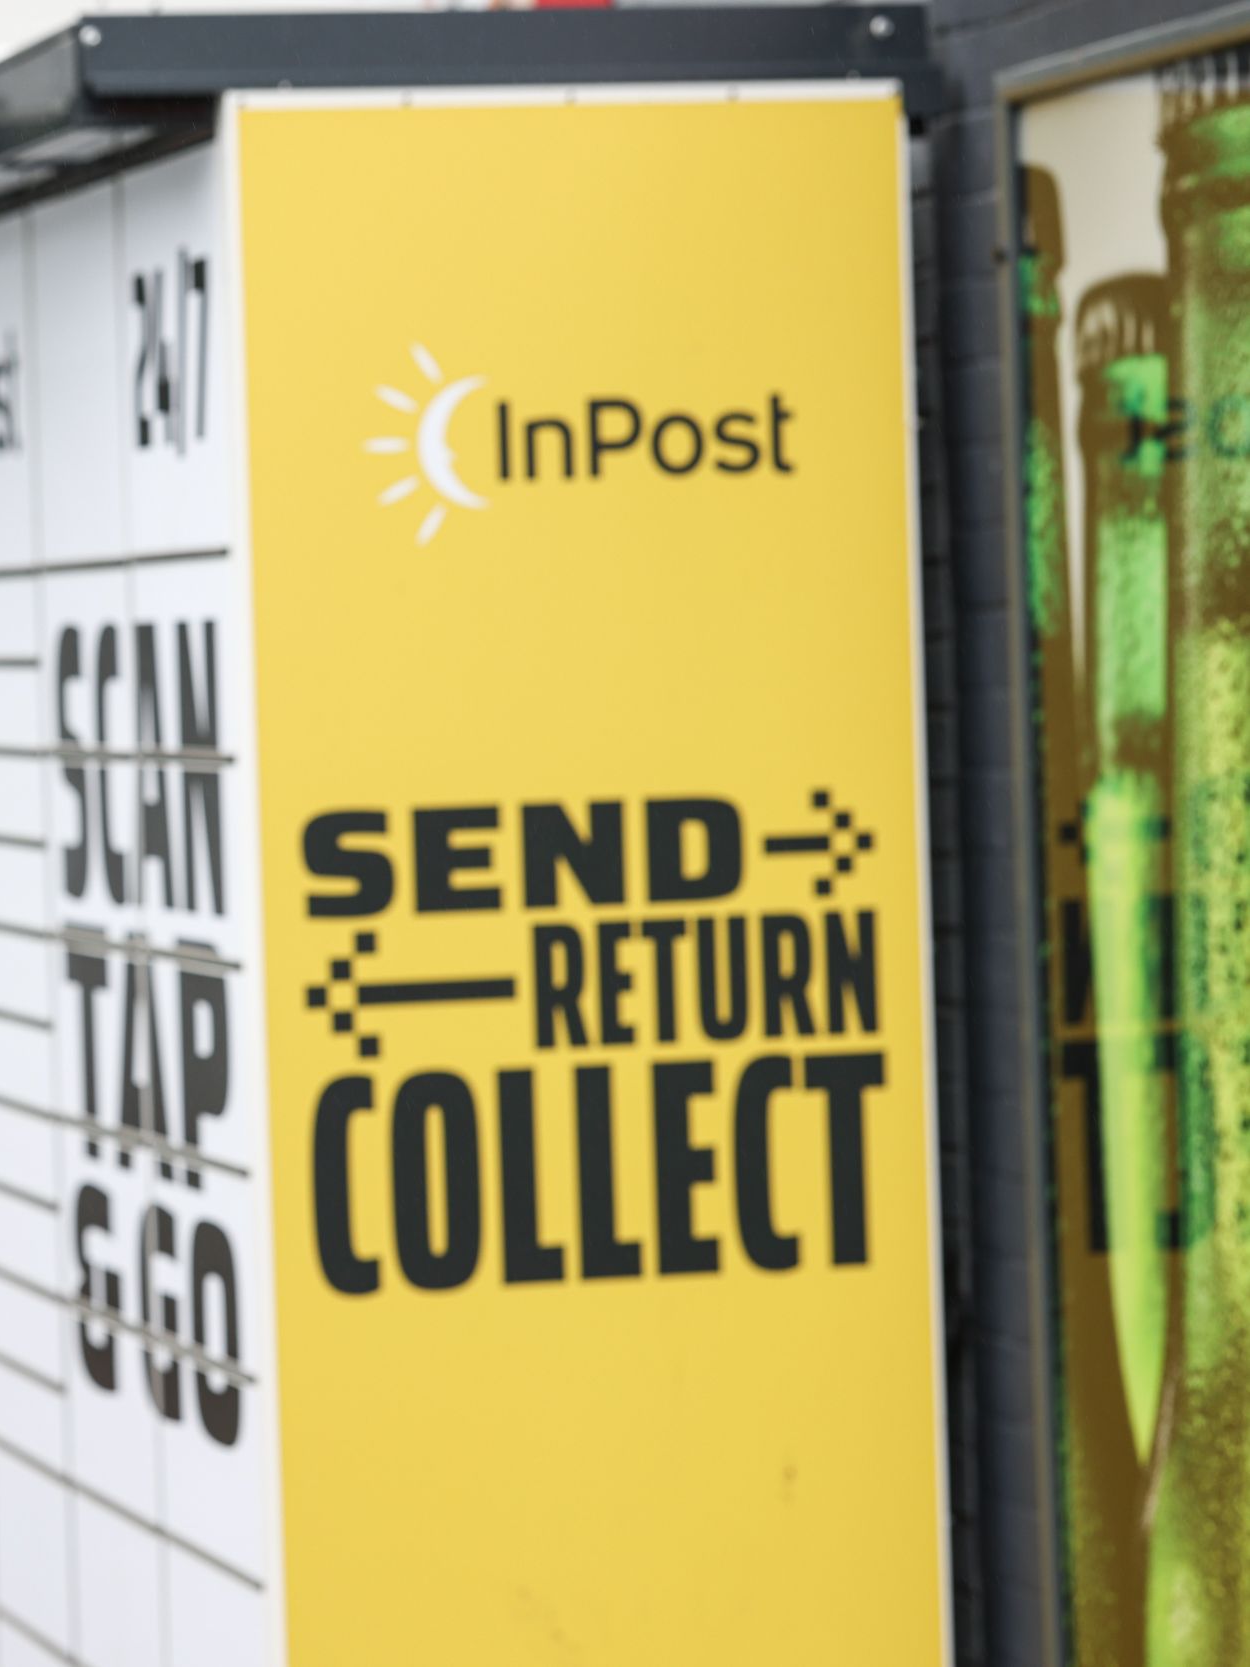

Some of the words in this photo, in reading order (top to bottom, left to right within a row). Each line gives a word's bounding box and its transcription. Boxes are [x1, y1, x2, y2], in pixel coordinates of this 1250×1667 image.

[133, 246, 207, 457] 24/7
[496, 392, 795, 481] InPost
[58, 619, 225, 917] SCAN
[300, 794, 745, 921] SEND
[63, 922, 230, 1191] TAP
[532, 907, 883, 1051] RETURN
[310, 1050, 887, 1297] COLLECT
